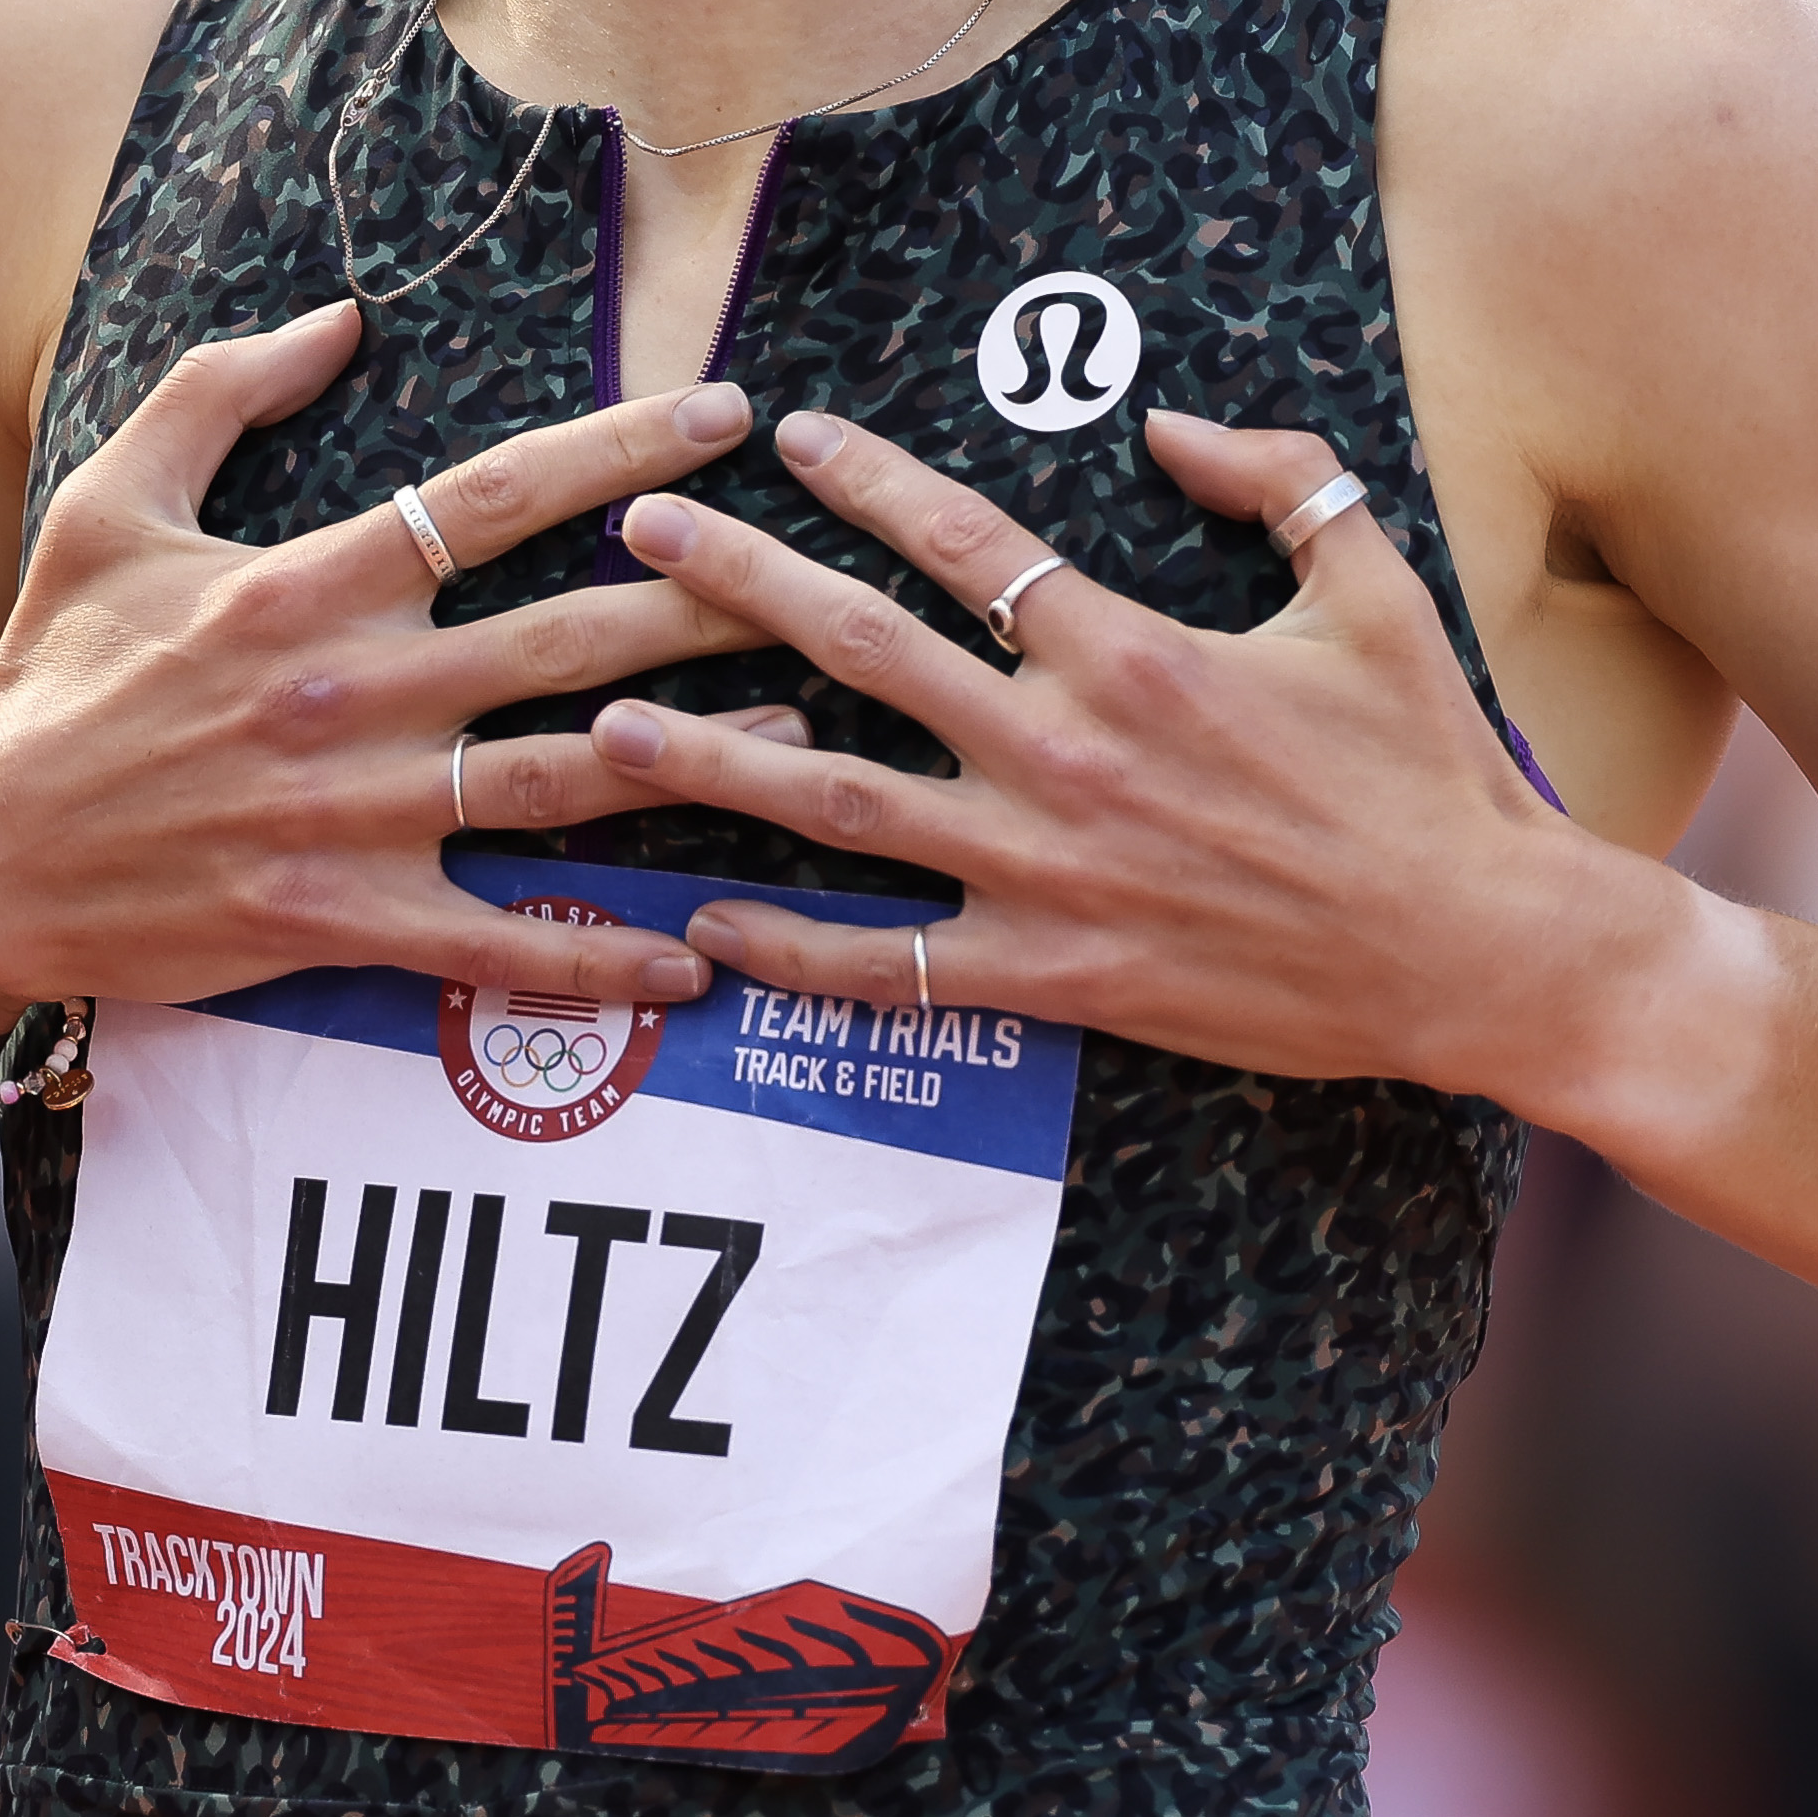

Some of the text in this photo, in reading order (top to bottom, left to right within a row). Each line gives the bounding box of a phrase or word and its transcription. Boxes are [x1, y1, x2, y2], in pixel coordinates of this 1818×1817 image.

[740, 987, 1023, 1069] TEAM TRIALS
[456, 1068, 622, 1136] OLYMPIC TEAM
[733, 1046, 942, 1108] TRACK & FIELD
[264, 1176, 766, 1458] HILTZ
[92, 1522, 325, 1619] TRACKTOWN
[211, 1599, 307, 1679] 2024
